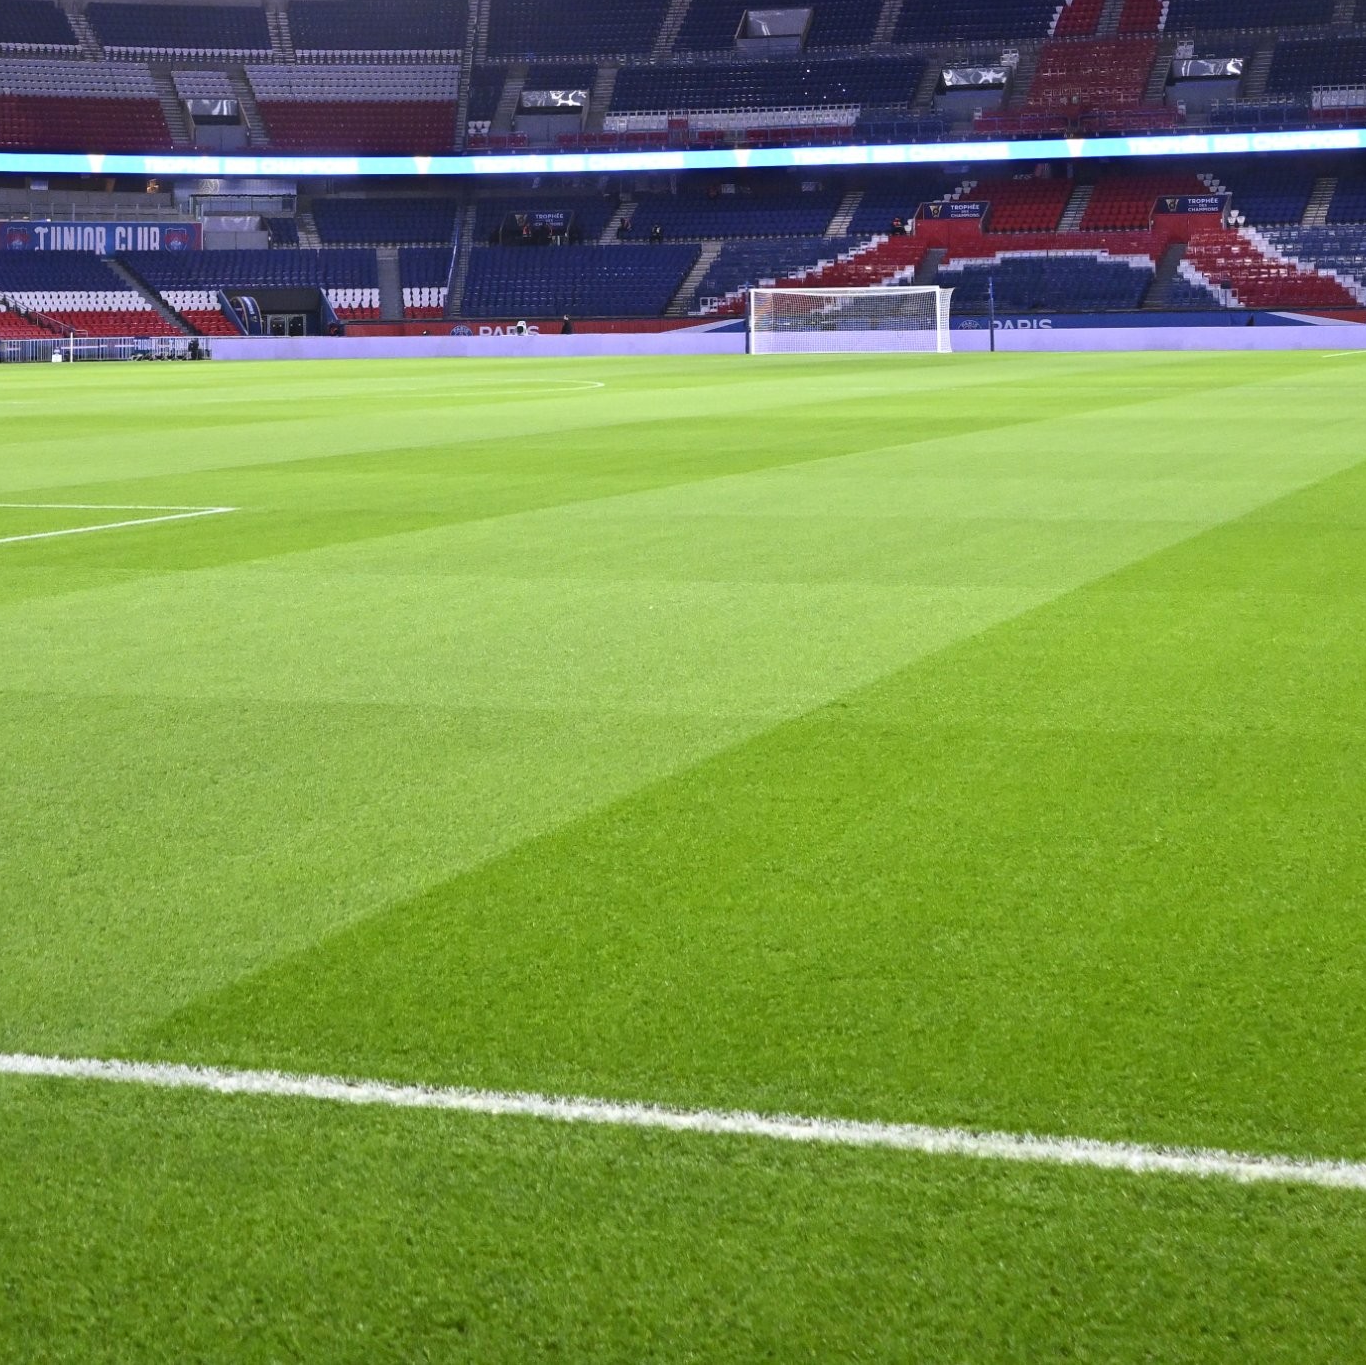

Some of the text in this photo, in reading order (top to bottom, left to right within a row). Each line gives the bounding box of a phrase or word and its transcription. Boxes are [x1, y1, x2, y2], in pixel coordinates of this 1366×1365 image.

[34, 226, 160, 255] JUNIOR CLUB
[988, 319, 1053, 330] PARIS
[479, 326, 539, 337] PARS
